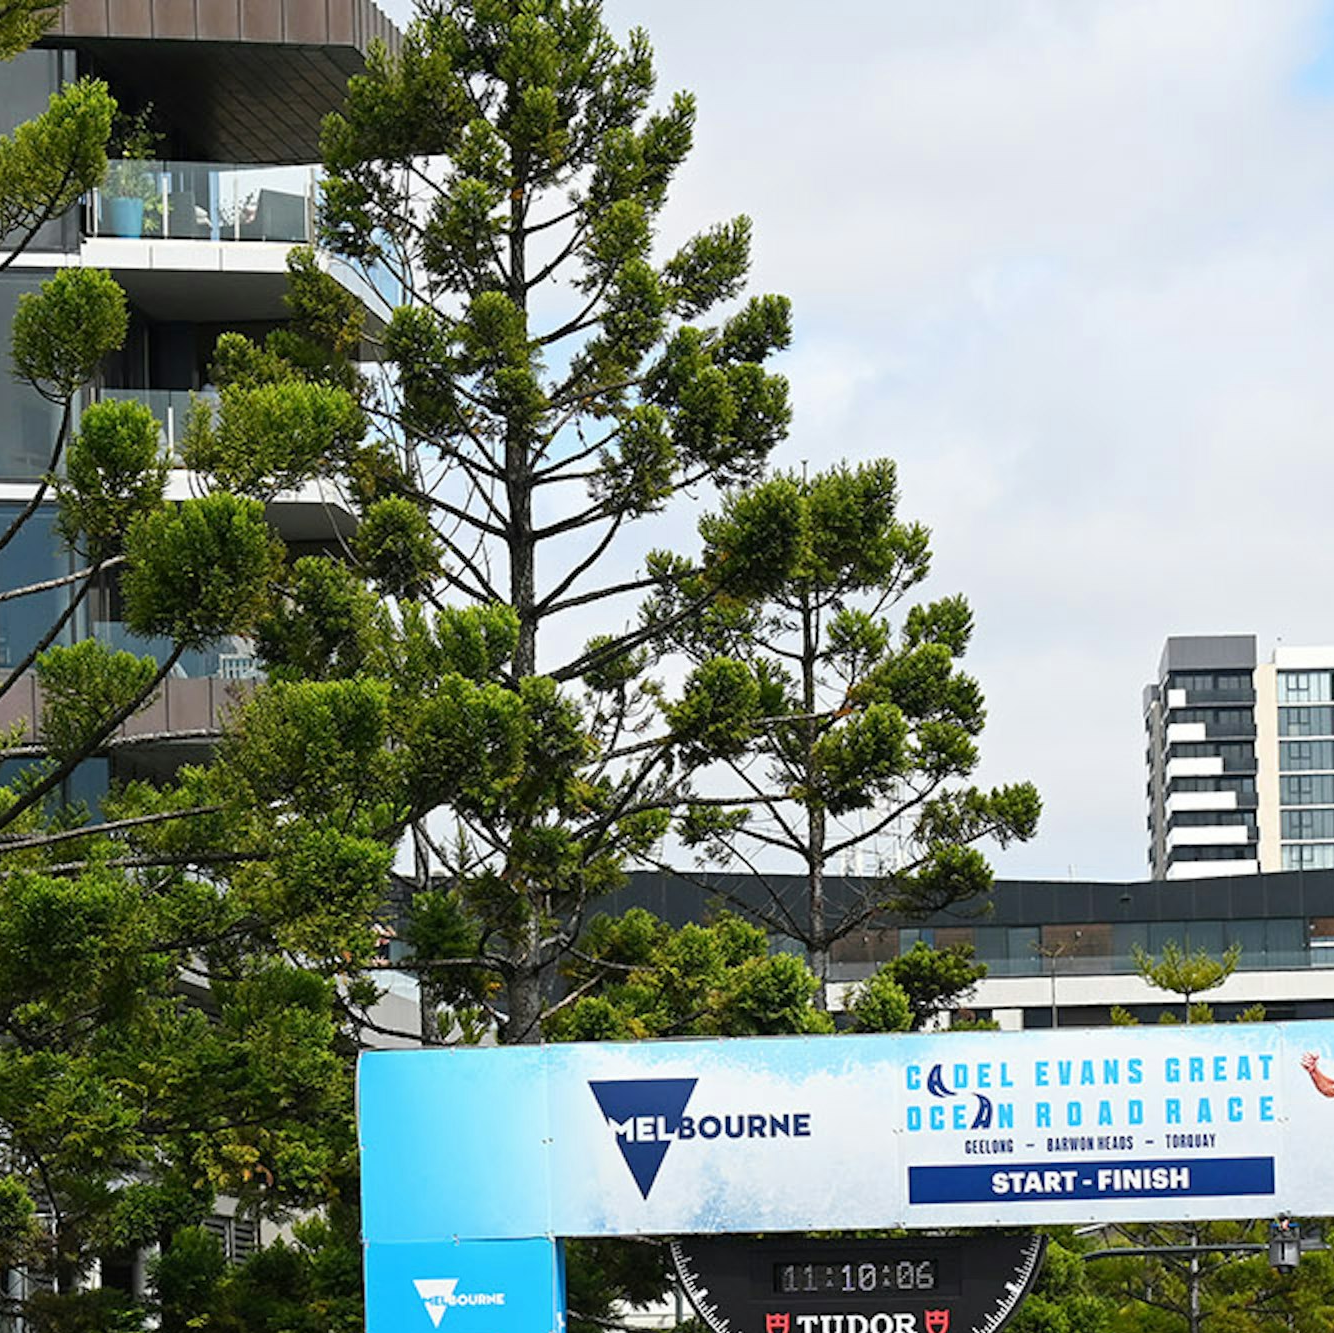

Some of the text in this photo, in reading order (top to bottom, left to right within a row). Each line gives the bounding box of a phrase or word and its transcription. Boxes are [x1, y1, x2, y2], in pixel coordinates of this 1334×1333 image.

[906, 1055, 1274, 1098] CADEL EVANS GREAT
[608, 1113, 812, 1142] MELBOURNE
[906, 1093, 1275, 1132] OCEAN ROAD RACE
[965, 1138, 1014, 1155] GEELONG
[1047, 1136, 1095, 1153] BARWON
[1097, 1136, 1134, 1151] HEADS
[1165, 1133, 1217, 1149] TORQUAY
[991, 1171, 1078, 1194] START
[1098, 1168, 1191, 1192] FINISH
[783, 1260, 935, 1292] 11:10:06
